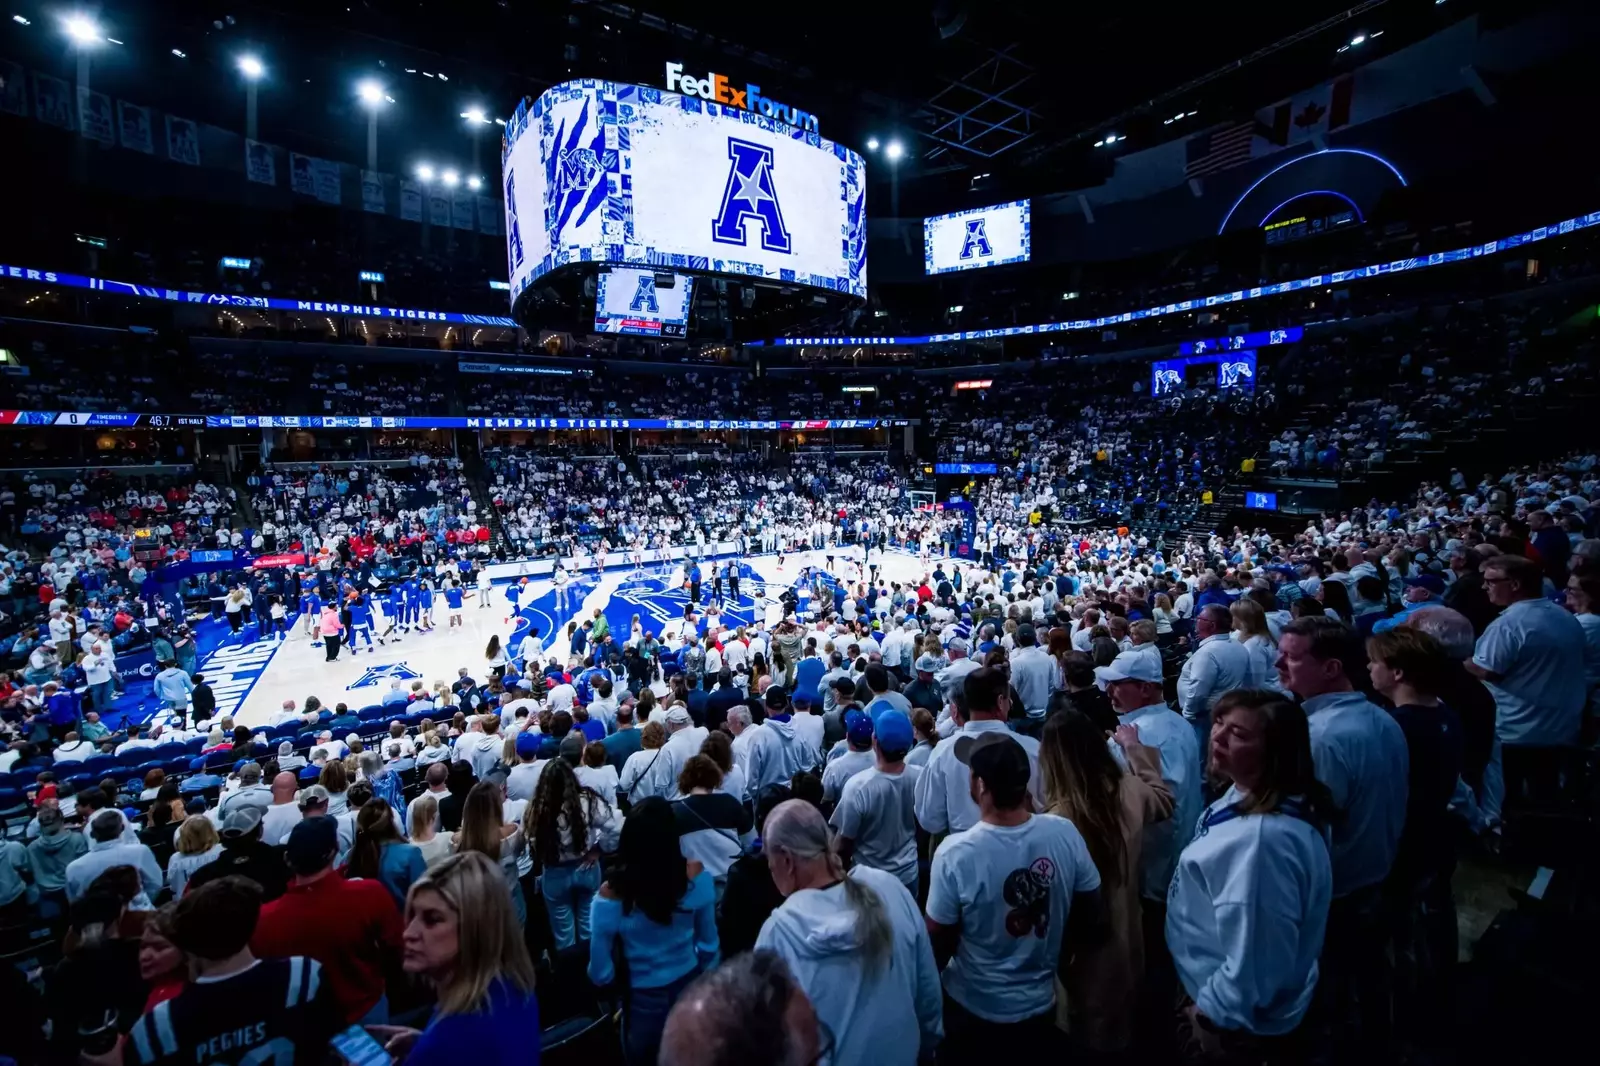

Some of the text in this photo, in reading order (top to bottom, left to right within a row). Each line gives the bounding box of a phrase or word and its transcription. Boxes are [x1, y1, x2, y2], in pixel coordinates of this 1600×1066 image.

[666, 61, 819, 134] FedExForum
[712, 136, 791, 254] A
[298, 301, 447, 321] MEMPHIS TIGERS
[69, 413, 78, 424] 0
[149, 415, 170, 426] 46.7
[467, 418, 630, 428] MEMPHIS TIGERS
[196, 1021, 267, 1065] PEGUES
